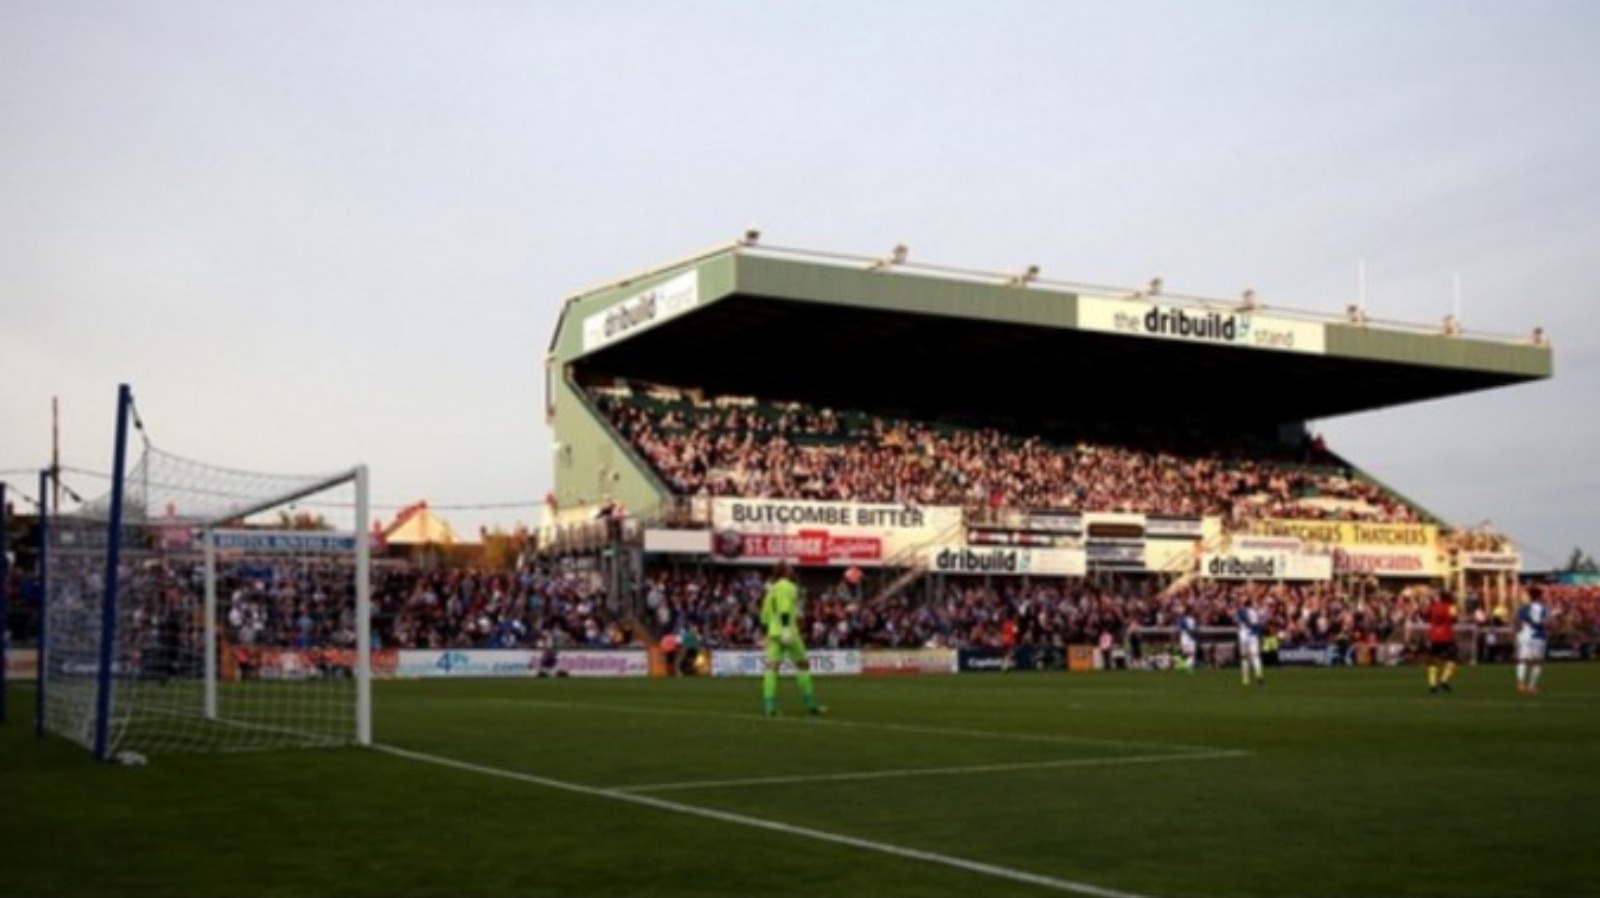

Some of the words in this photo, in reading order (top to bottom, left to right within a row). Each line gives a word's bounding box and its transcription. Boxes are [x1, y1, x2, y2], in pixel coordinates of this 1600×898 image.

[1144, 307, 1236, 340] dribuild
[732, 503, 851, 526] BUTCOMBE
[857, 505, 925, 528] BITTER
[936, 552, 1017, 571] dribuild
[1208, 555, 1275, 576] dribuild
